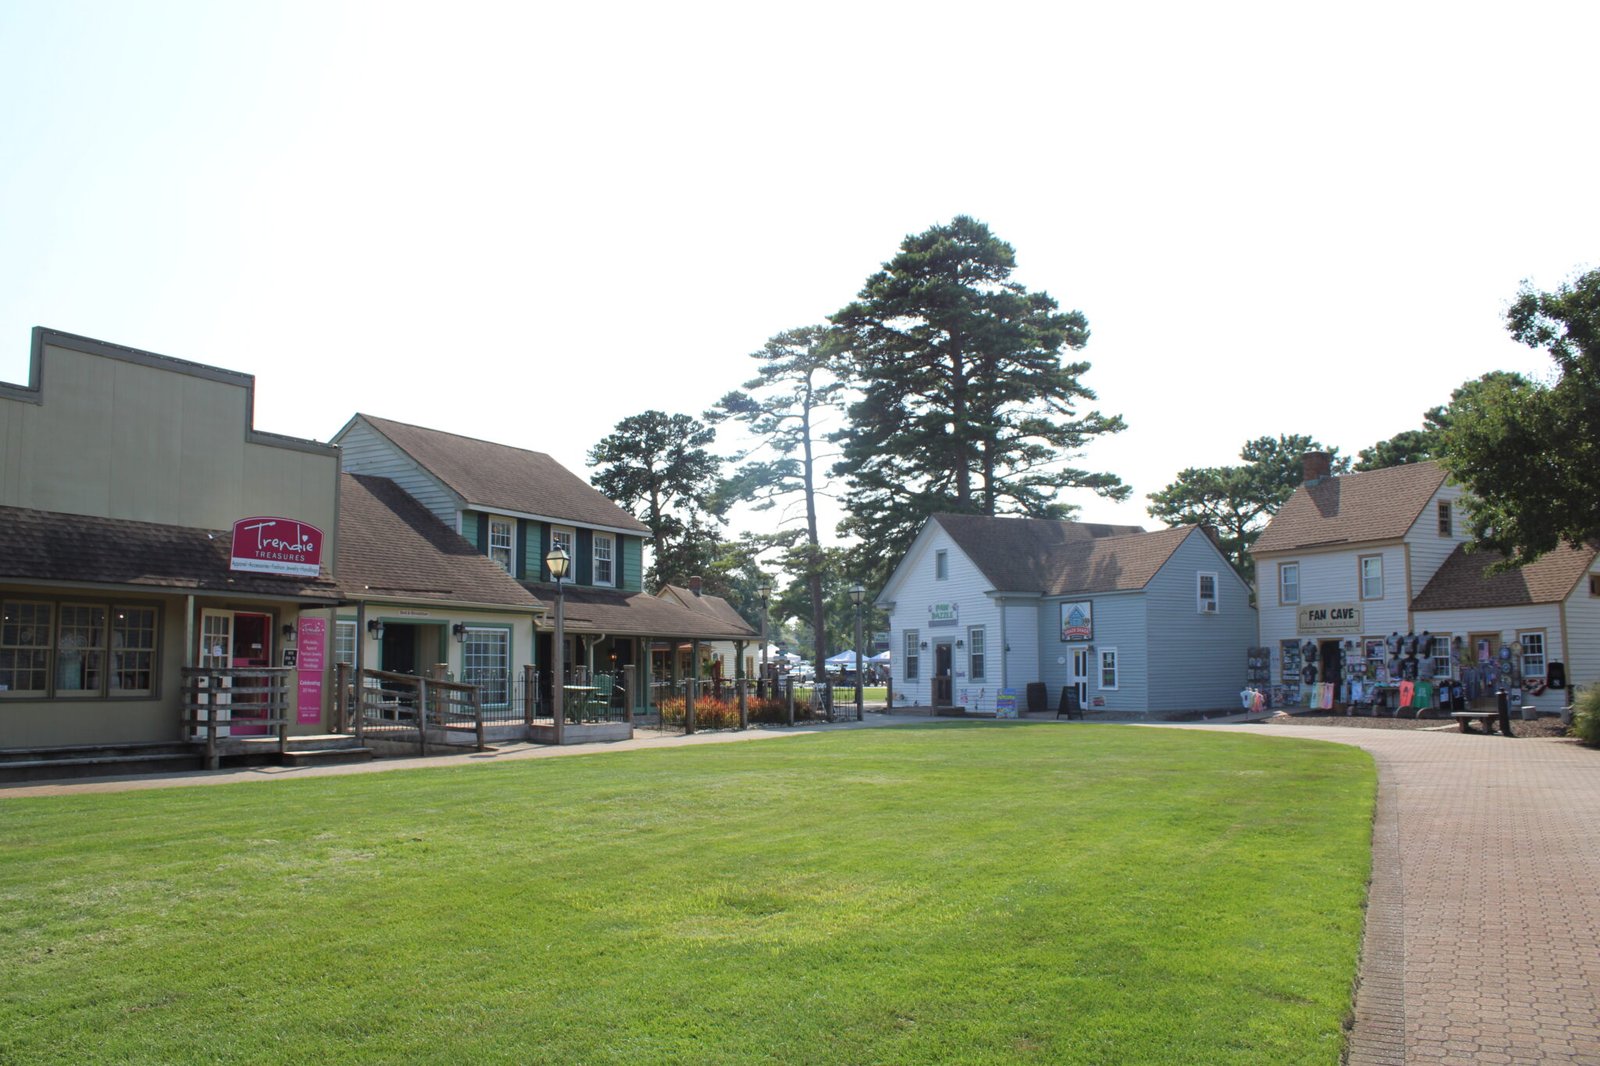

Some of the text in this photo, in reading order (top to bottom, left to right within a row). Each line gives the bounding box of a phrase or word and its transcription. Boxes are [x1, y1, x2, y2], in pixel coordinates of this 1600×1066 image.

[244, 521, 313, 552] Trendie
[255, 551, 305, 561] TREASURES
[1309, 608, 1354, 620] FAN CAVE
